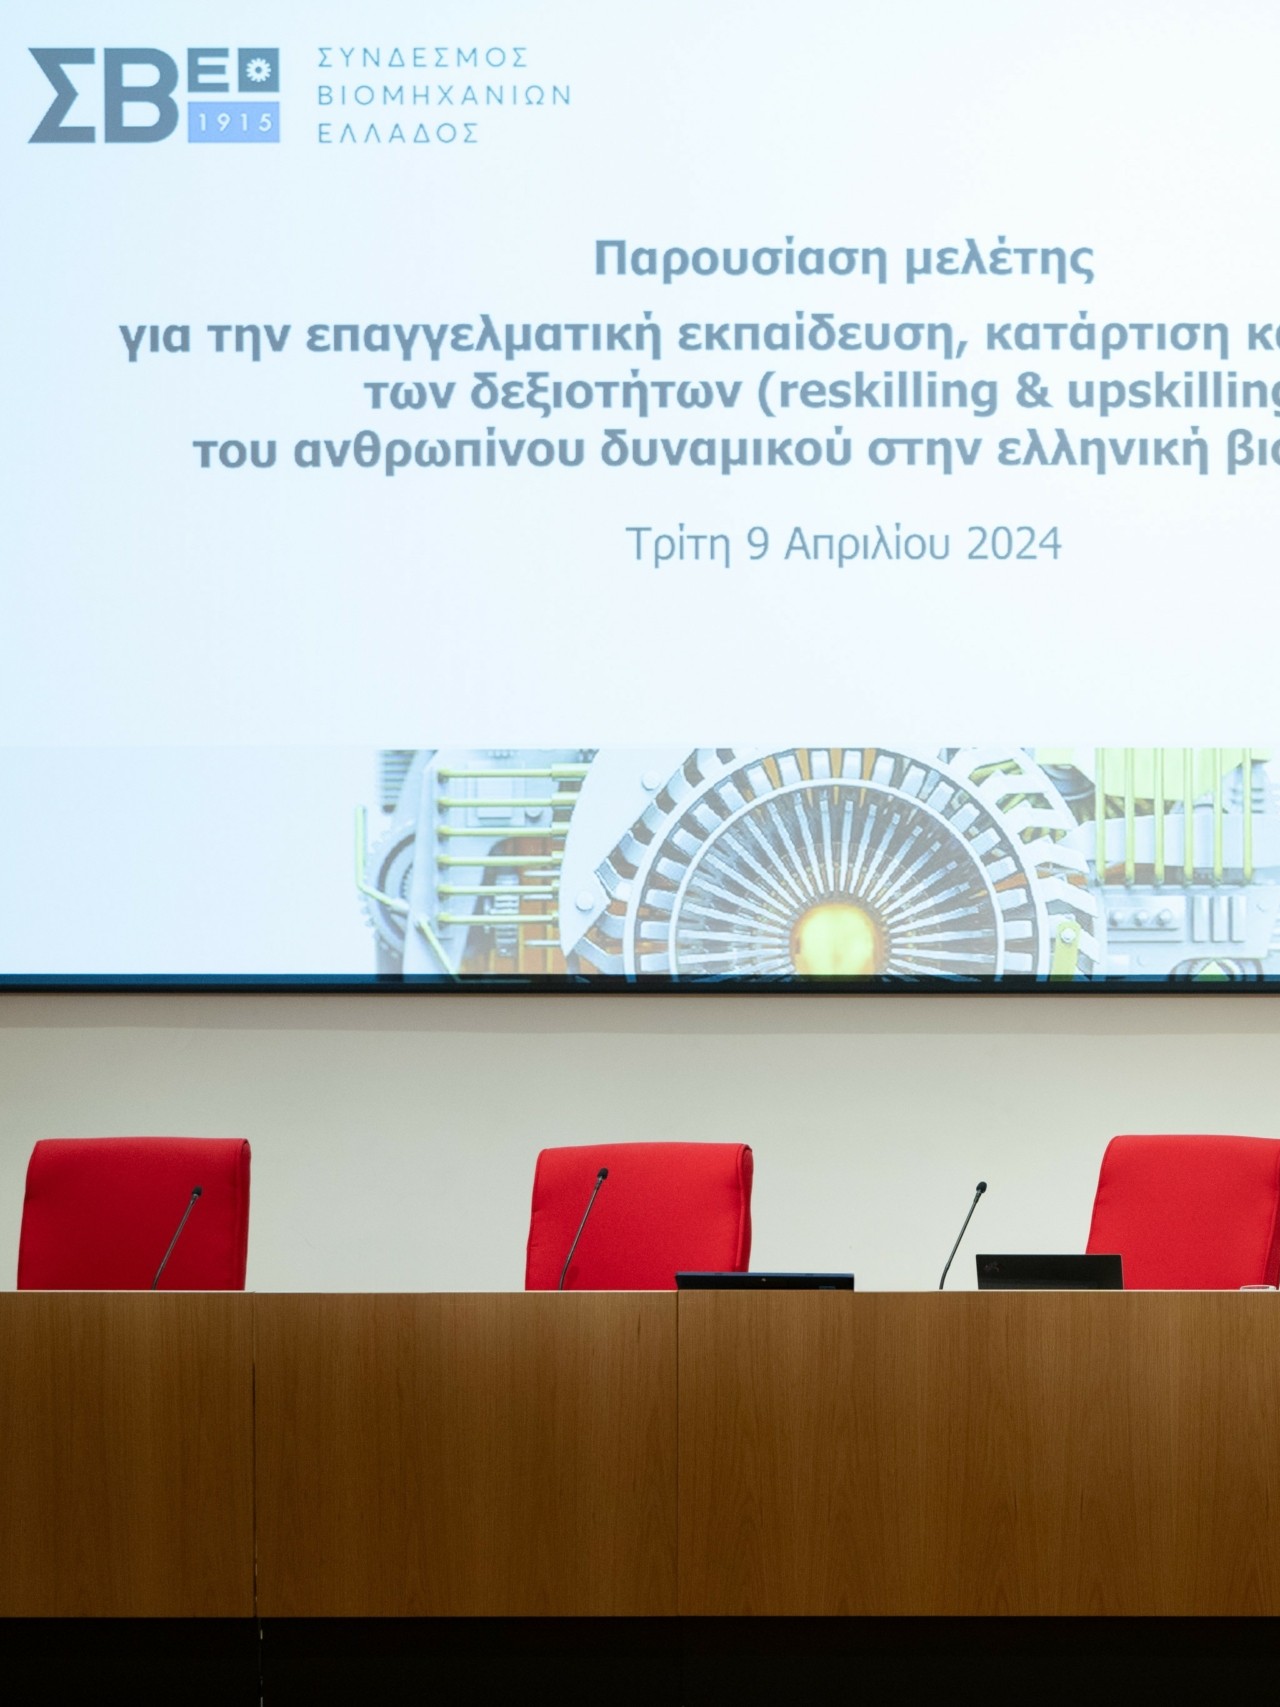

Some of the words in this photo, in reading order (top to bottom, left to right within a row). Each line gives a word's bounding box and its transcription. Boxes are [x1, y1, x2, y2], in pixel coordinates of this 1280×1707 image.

[317, 46, 528, 69] ΣΥΝΔΕΣΜΟΣ
[317, 84, 571, 106] ΒΙΟΜΗΧΑΝΙΩΝ
[199, 112, 273, 132] 1915
[317, 122, 478, 144] ΕΛΛΑΔΟΣ
[595, 235, 887, 285] Παρουσίαση
[906, 235, 1095, 285] μελέτης
[118, 324, 191, 363] για
[207, 324, 292, 362] την
[306, 310, 661, 362] επαγγελματική
[678, 310, 968, 360] εκπαίδευση,
[987, 310, 1229, 360] κατάρτιση
[363, 382, 456, 410] των
[471, 368, 743, 418] δεξιοτήτων
[758, 371, 998, 418] (reskilling
[1016, 371, 1054, 409] &
[192, 440, 277, 469] του
[294, 426, 585, 477] ανθρωπίνου
[601, 425, 852, 476] δυναμικού
[868, 437, 983, 475] στην
[997, 425, 1208, 475] ελληνική
[625, 522, 730, 569] Τρίτη
[747, 526, 769, 560] 9
[784, 522, 950, 568] Απριλίου
[968, 525, 1062, 560] 2024
